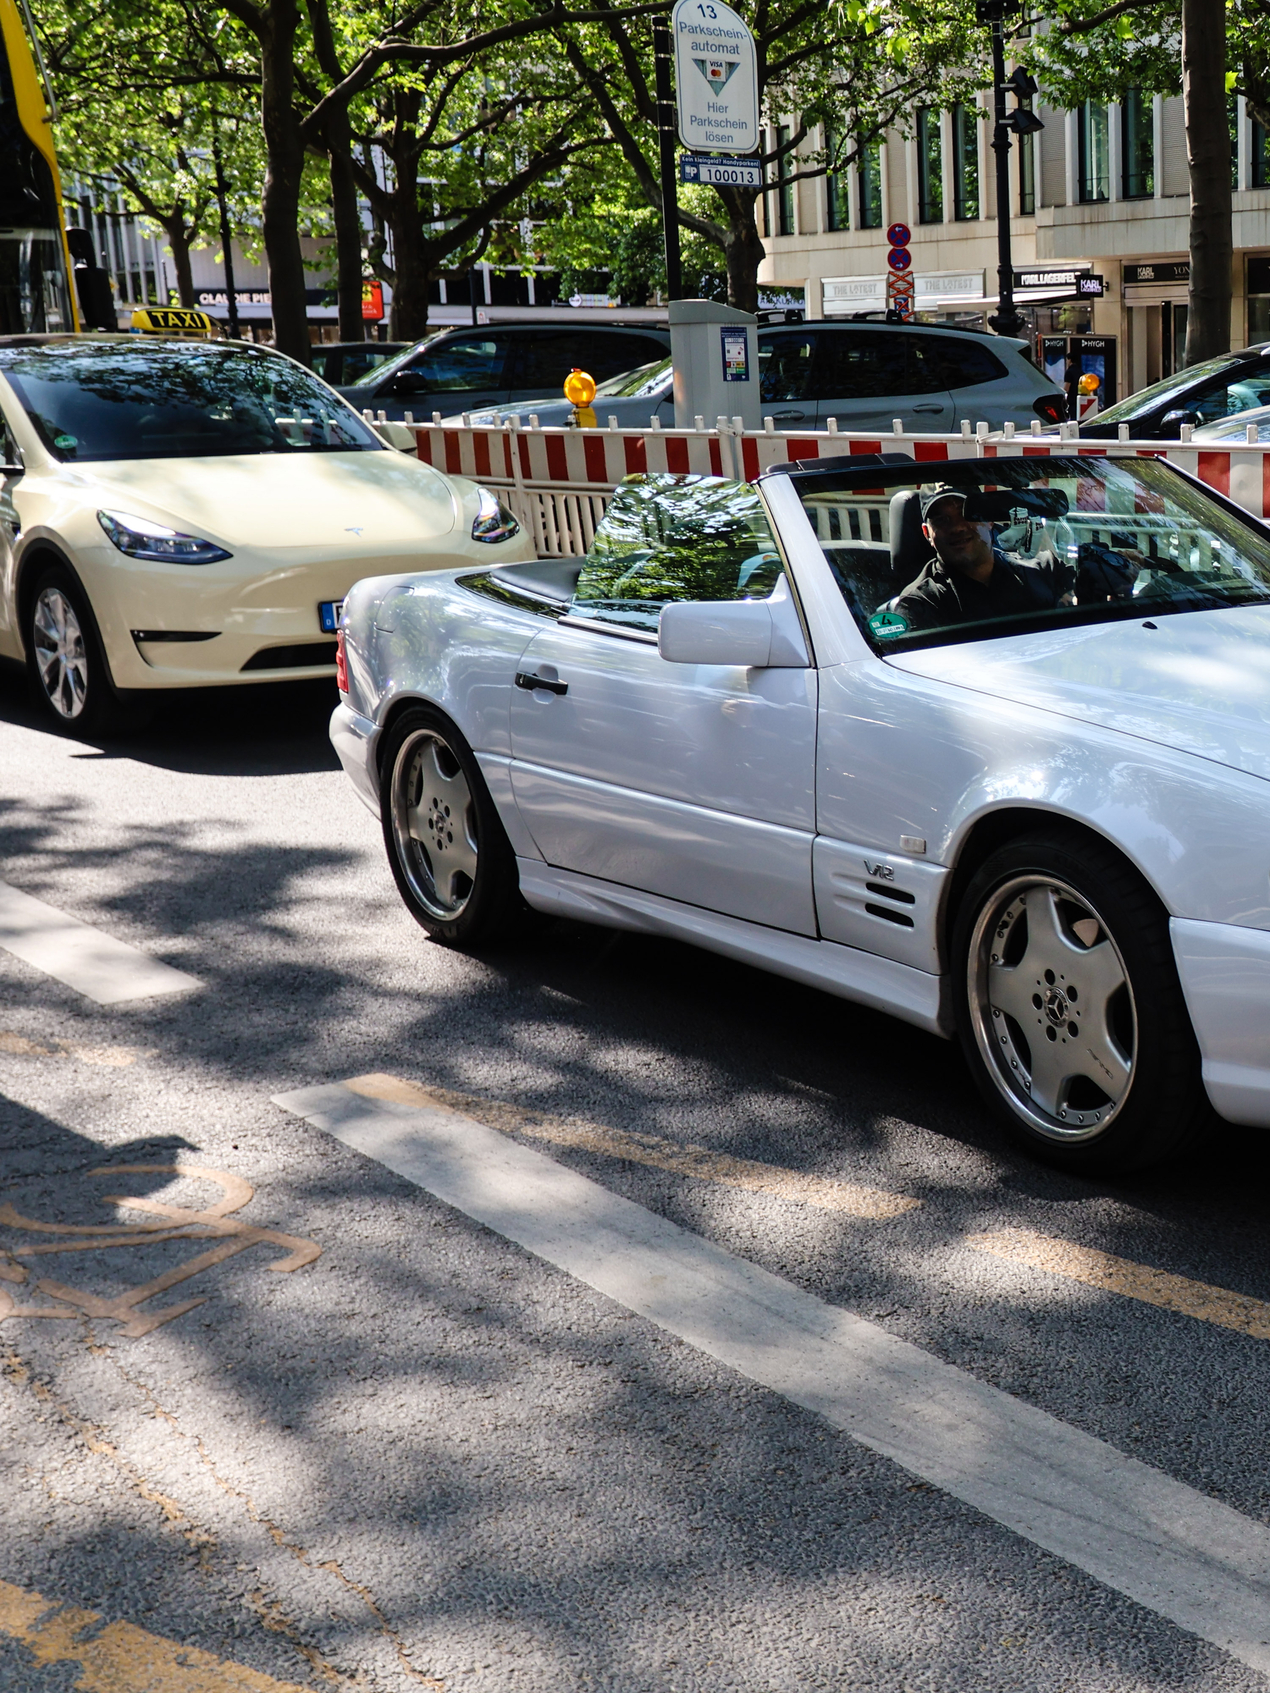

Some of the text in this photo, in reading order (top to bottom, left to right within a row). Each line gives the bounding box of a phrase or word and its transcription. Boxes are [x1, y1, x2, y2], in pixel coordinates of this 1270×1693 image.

[697, 4, 718, 20] 13
[679, 21, 748, 40] Parkschein-
[691, 41, 741, 55] automat
[707, 102, 729, 114] Hier
[690, 115, 748, 130] Parkschein
[705, 131, 734, 143] lösen
[707, 169, 754, 184] 100013
[1040, 271, 1081, 285] LAGERFEL
[1081, 279, 1102, 288] KARL
[833, 285, 848, 296] THE
[924, 280, 941, 291] THE
[151, 311, 202, 328] TAXI
[1087, 340, 1105, 348] HYGH
[881, 615, 893, 626] 4
[863, 859, 895, 881] V12
